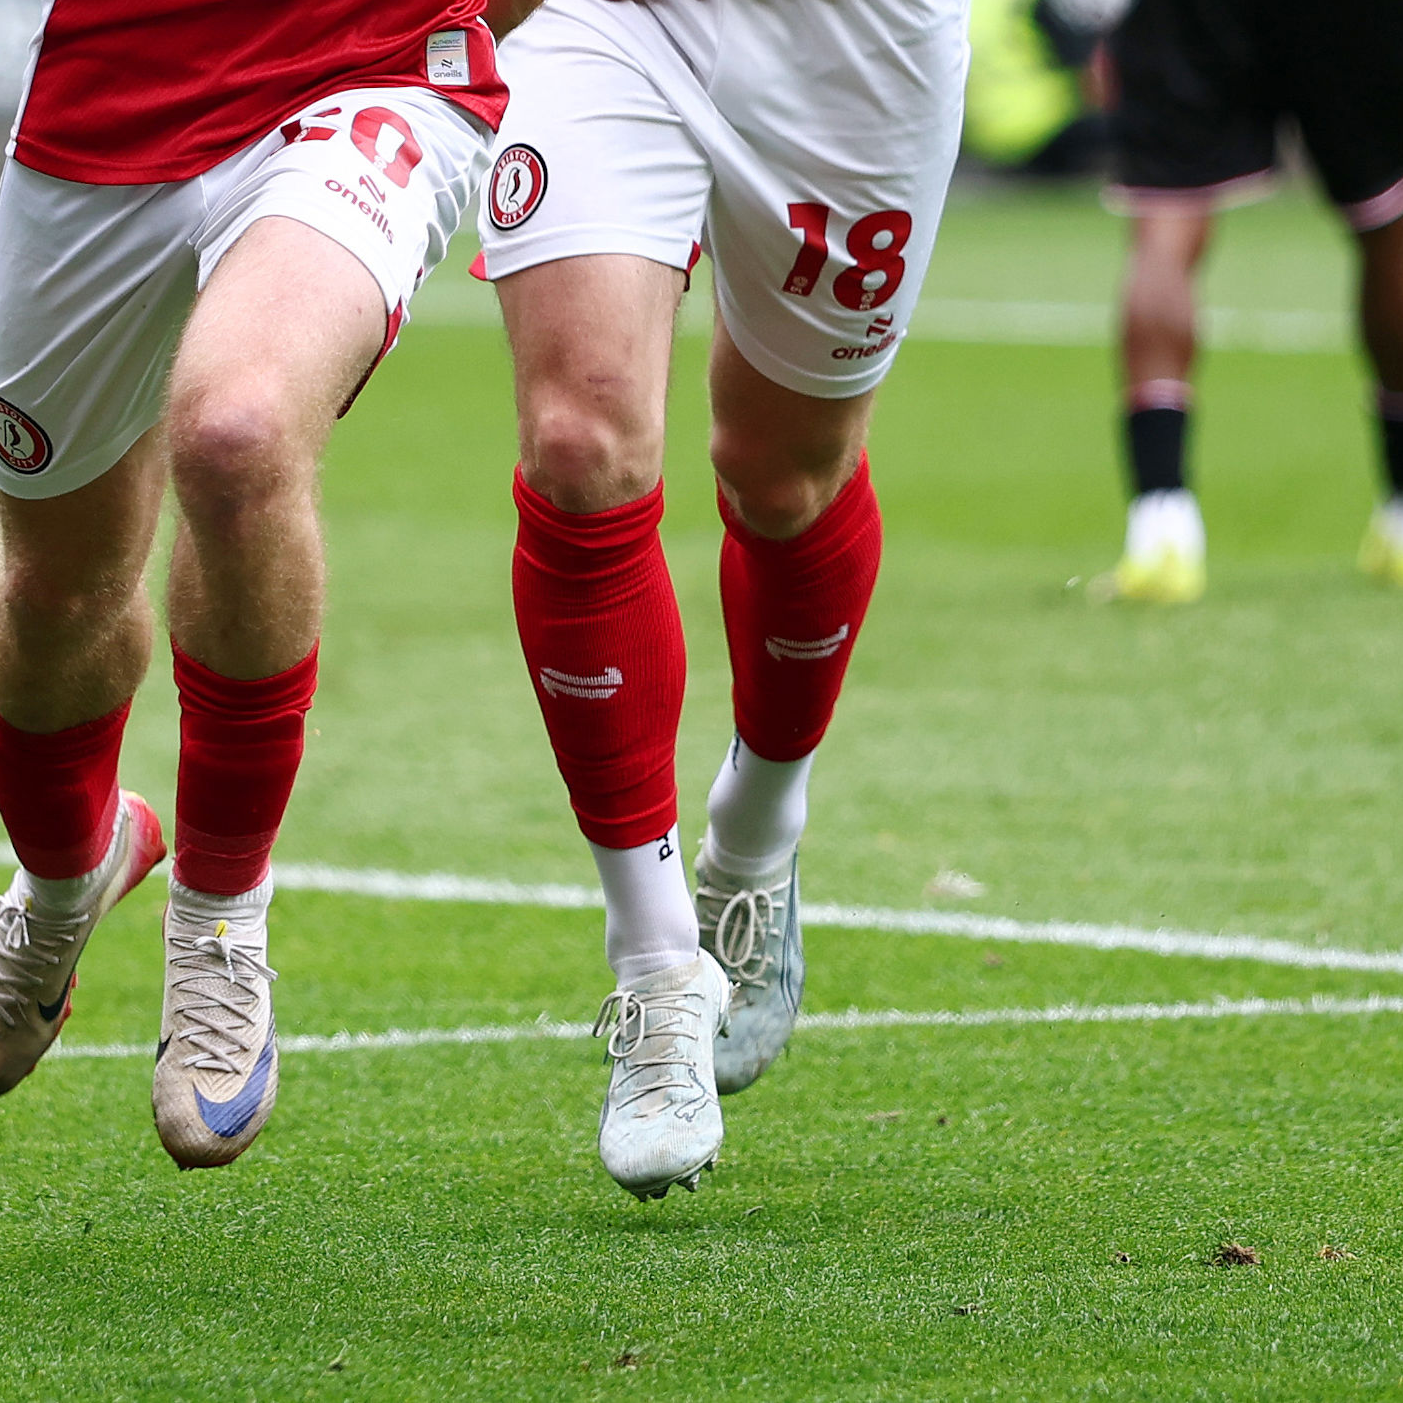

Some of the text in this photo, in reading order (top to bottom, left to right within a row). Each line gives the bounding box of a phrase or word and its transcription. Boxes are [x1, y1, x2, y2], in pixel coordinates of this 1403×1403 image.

[325, 179, 395, 245] o'neills
[501, 206, 524, 224] CITY
[782, 202, 912, 312] 18
